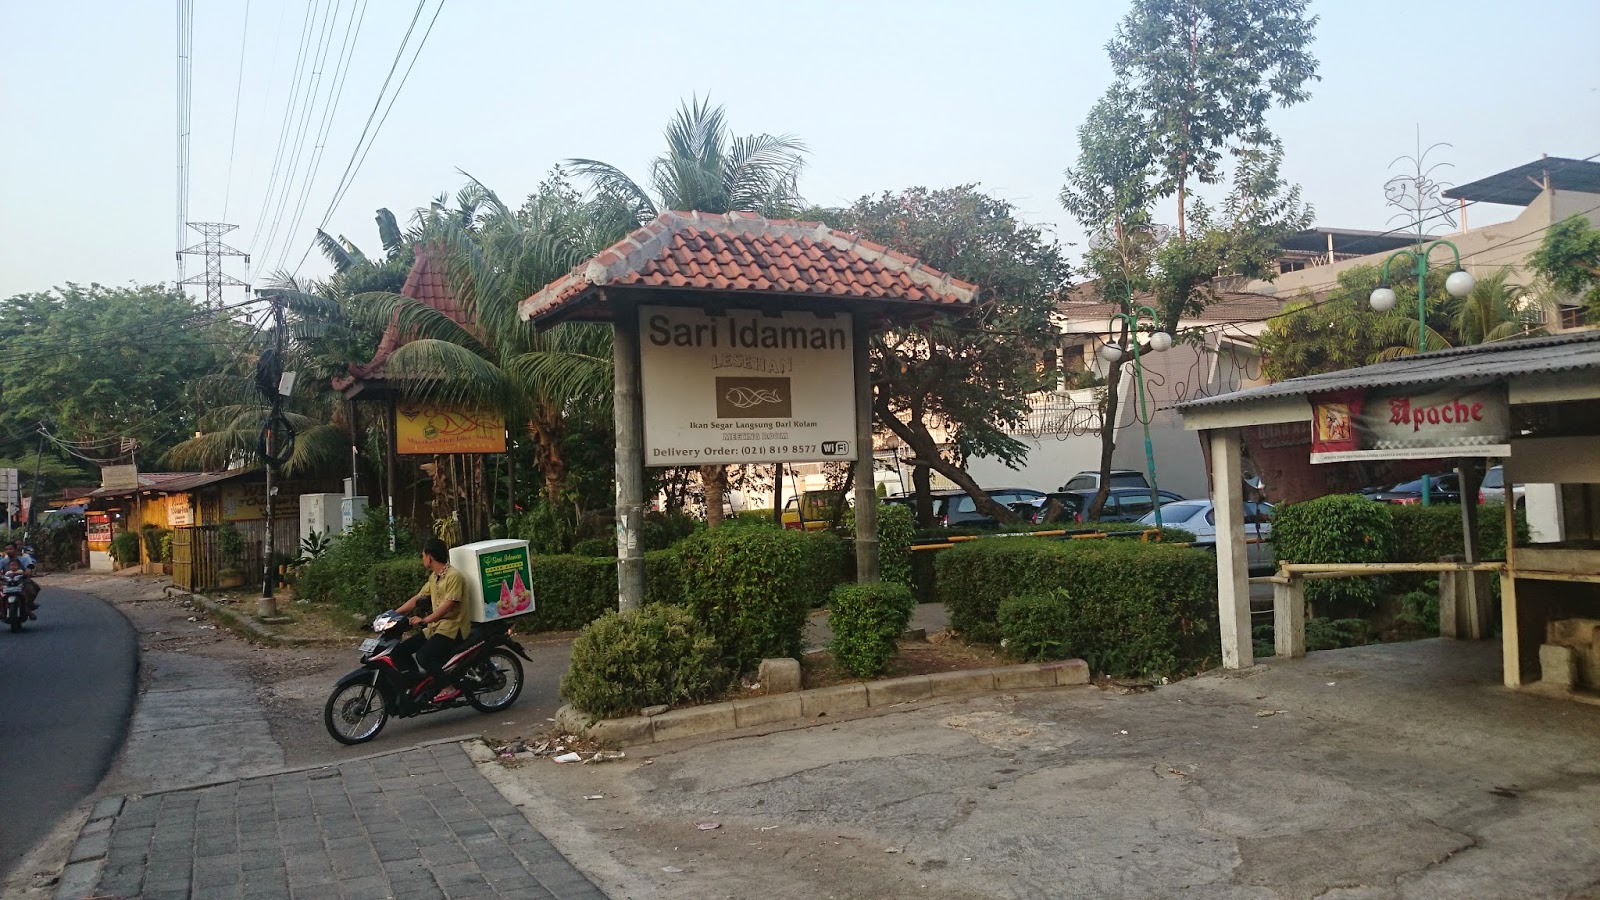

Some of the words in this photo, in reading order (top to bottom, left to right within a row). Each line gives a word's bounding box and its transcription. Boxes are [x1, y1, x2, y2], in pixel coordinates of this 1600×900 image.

[649, 314, 718, 347] Sari
[730, 317, 846, 350] Idaman
[711, 353, 793, 374] LESEHAN
[1388, 396, 1484, 433] Apache
[689, 421, 708, 429] Ikan
[710, 421, 733, 430] Segar
[735, 421, 773, 430] Langsung
[793, 420, 818, 428] Kolam
[722, 432, 760, 441] MEETING
[761, 432, 789, 440] ROOM
[653, 447, 701, 458] Delivery
[706, 446, 739, 456] Order:
[741, 446, 766, 455] (021)
[769, 445, 789, 454] 819
[791, 444, 817, 453] 8577
